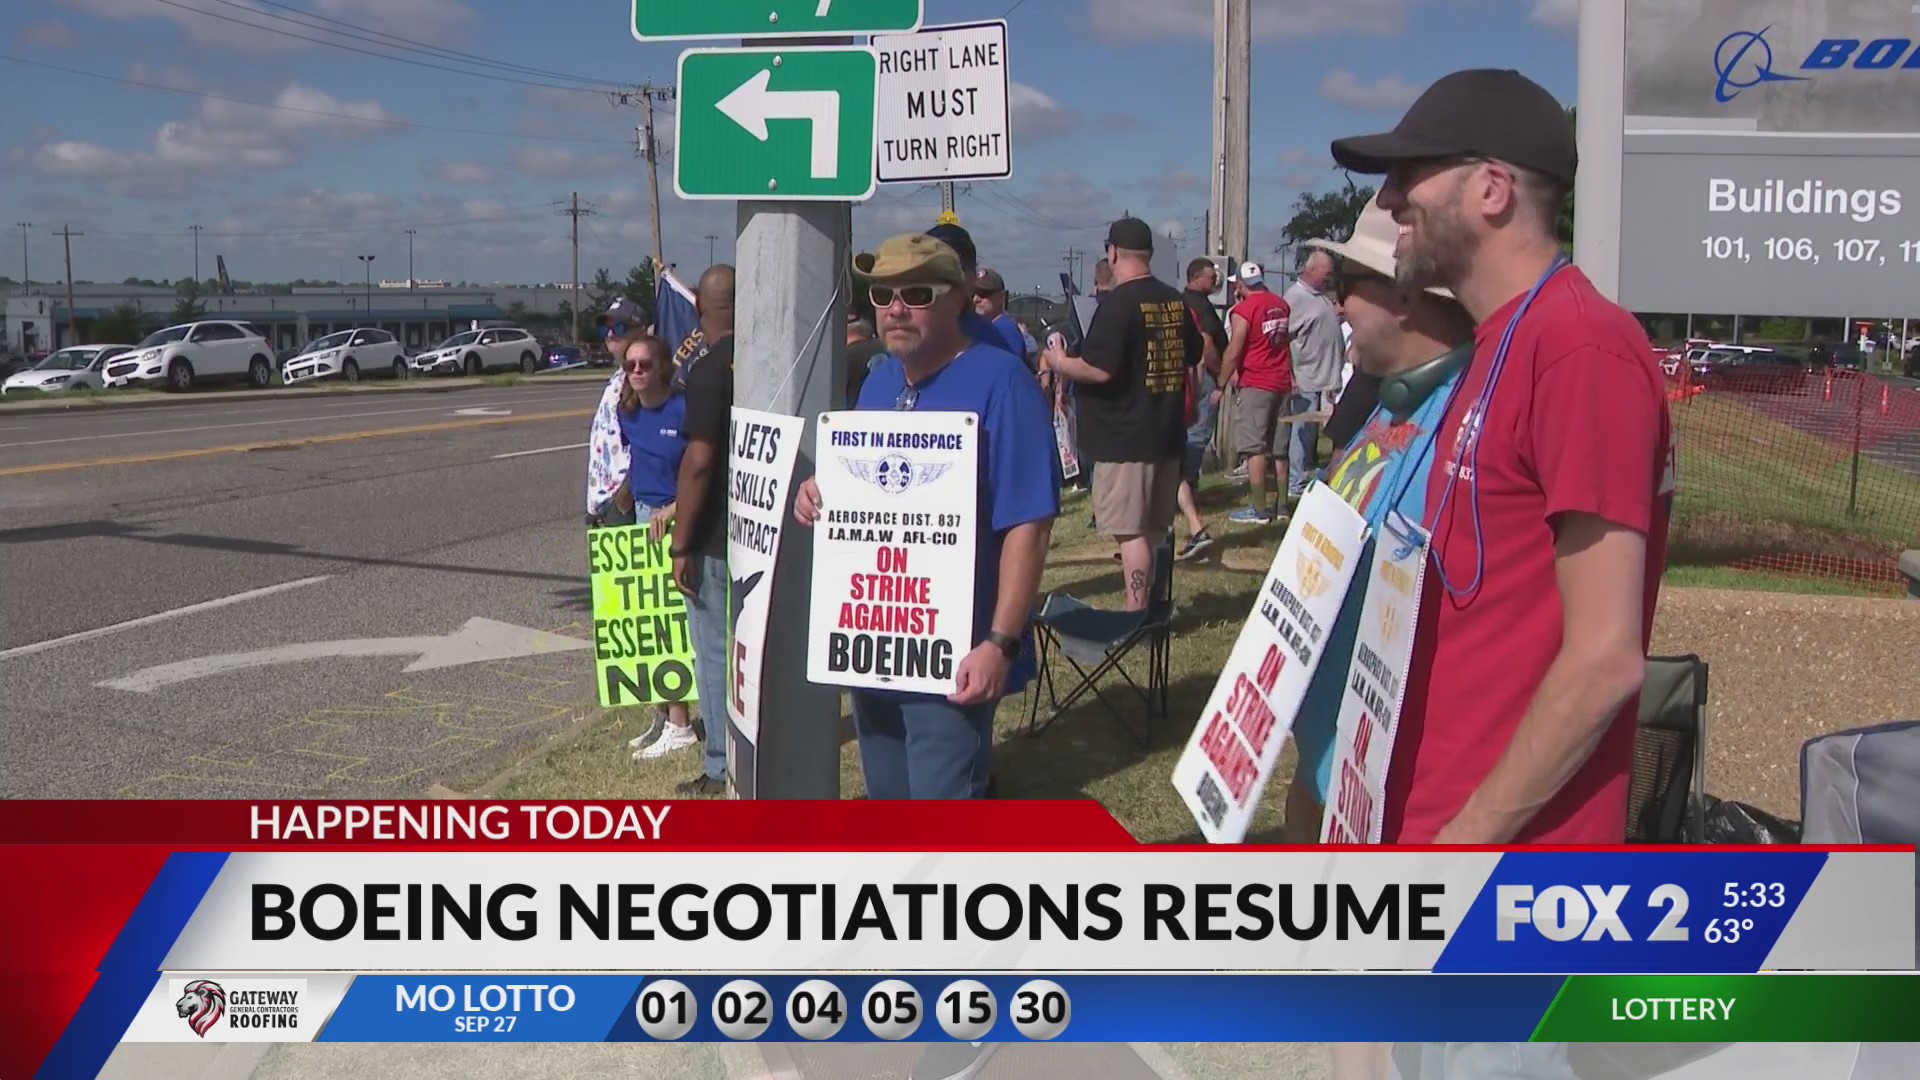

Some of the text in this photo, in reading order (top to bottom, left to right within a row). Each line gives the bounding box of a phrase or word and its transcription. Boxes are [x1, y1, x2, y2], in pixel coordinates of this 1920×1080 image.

[880, 43, 999, 73] RIGHT LANE
[907, 88, 978, 119] MUST
[884, 133, 1001, 162] TURN RIGHT
[1708, 178, 1901, 222] Buildings
[1702, 236, 1750, 263] 101,
[1764, 237, 1820, 264] 106,
[1833, 239, 1885, 265] 107,
[738, 422, 781, 464] JETS
[832, 431, 963, 450] FIRST IN AEROSPACE
[735, 470, 778, 511] SKILLS
[828, 510, 961, 528] AEROSPACE DIST. 837
[902, 531, 957, 545] AFL-CIO
[876, 546, 908, 574] ON
[615, 573, 684, 610] THE
[850, 573, 931, 604] STRIKE
[838, 603, 940, 635] AGAINST
[828, 632, 953, 680] BOEING
[606, 659, 695, 704] NO
